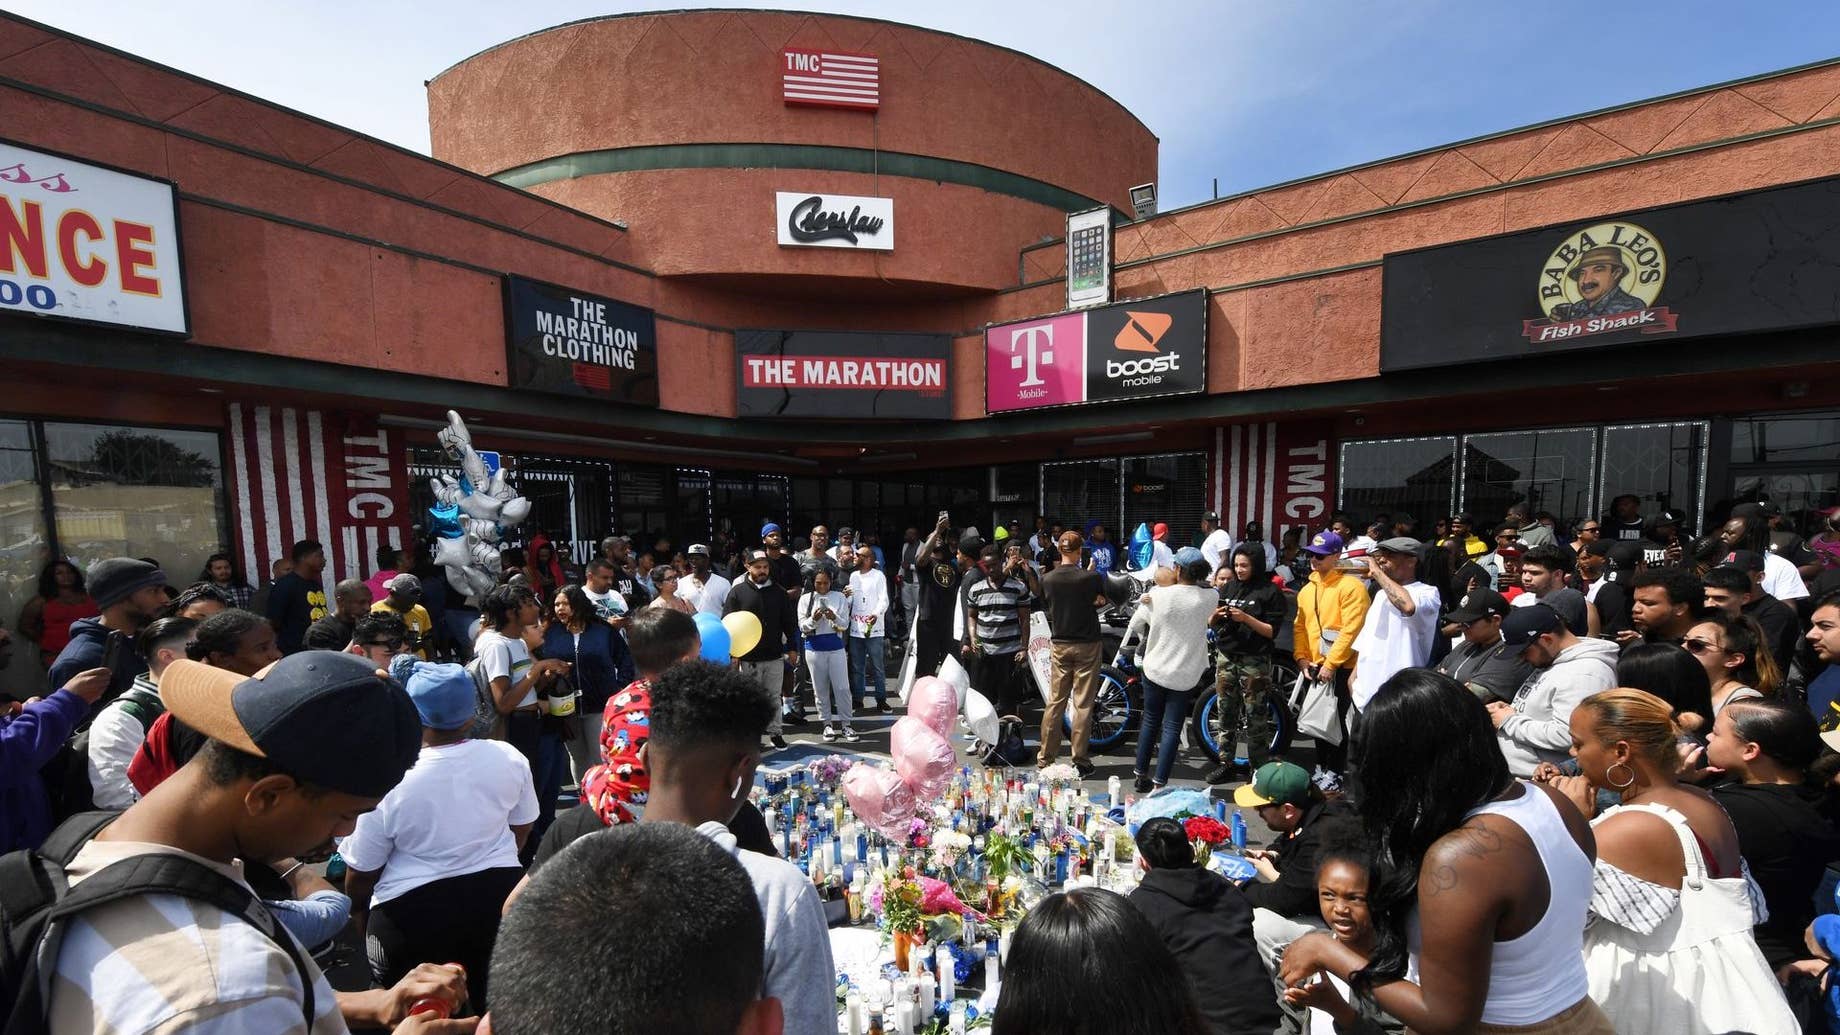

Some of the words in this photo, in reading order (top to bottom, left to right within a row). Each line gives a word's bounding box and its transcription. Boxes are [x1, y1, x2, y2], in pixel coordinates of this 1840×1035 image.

[785, 52, 820, 72] TMC
[788, 196, 884, 246] Crenshaw
[1541, 231, 1599, 301] BABA
[1607, 225, 1661, 285] LEO'S
[570, 296, 607, 325] THE
[1539, 323, 1582, 341] Fish
[1586, 310, 1656, 332] Shack
[536, 310, 638, 352] MARATHON
[543, 333, 636, 371] CLOTHING
[1106, 351, 1180, 379] boost
[748, 359, 797, 384] THE
[803, 360, 941, 387] MARATHON
[1122, 375, 1163, 388] mobile
[343, 429, 395, 519] TMC
[1285, 439, 1327, 519] TMC
